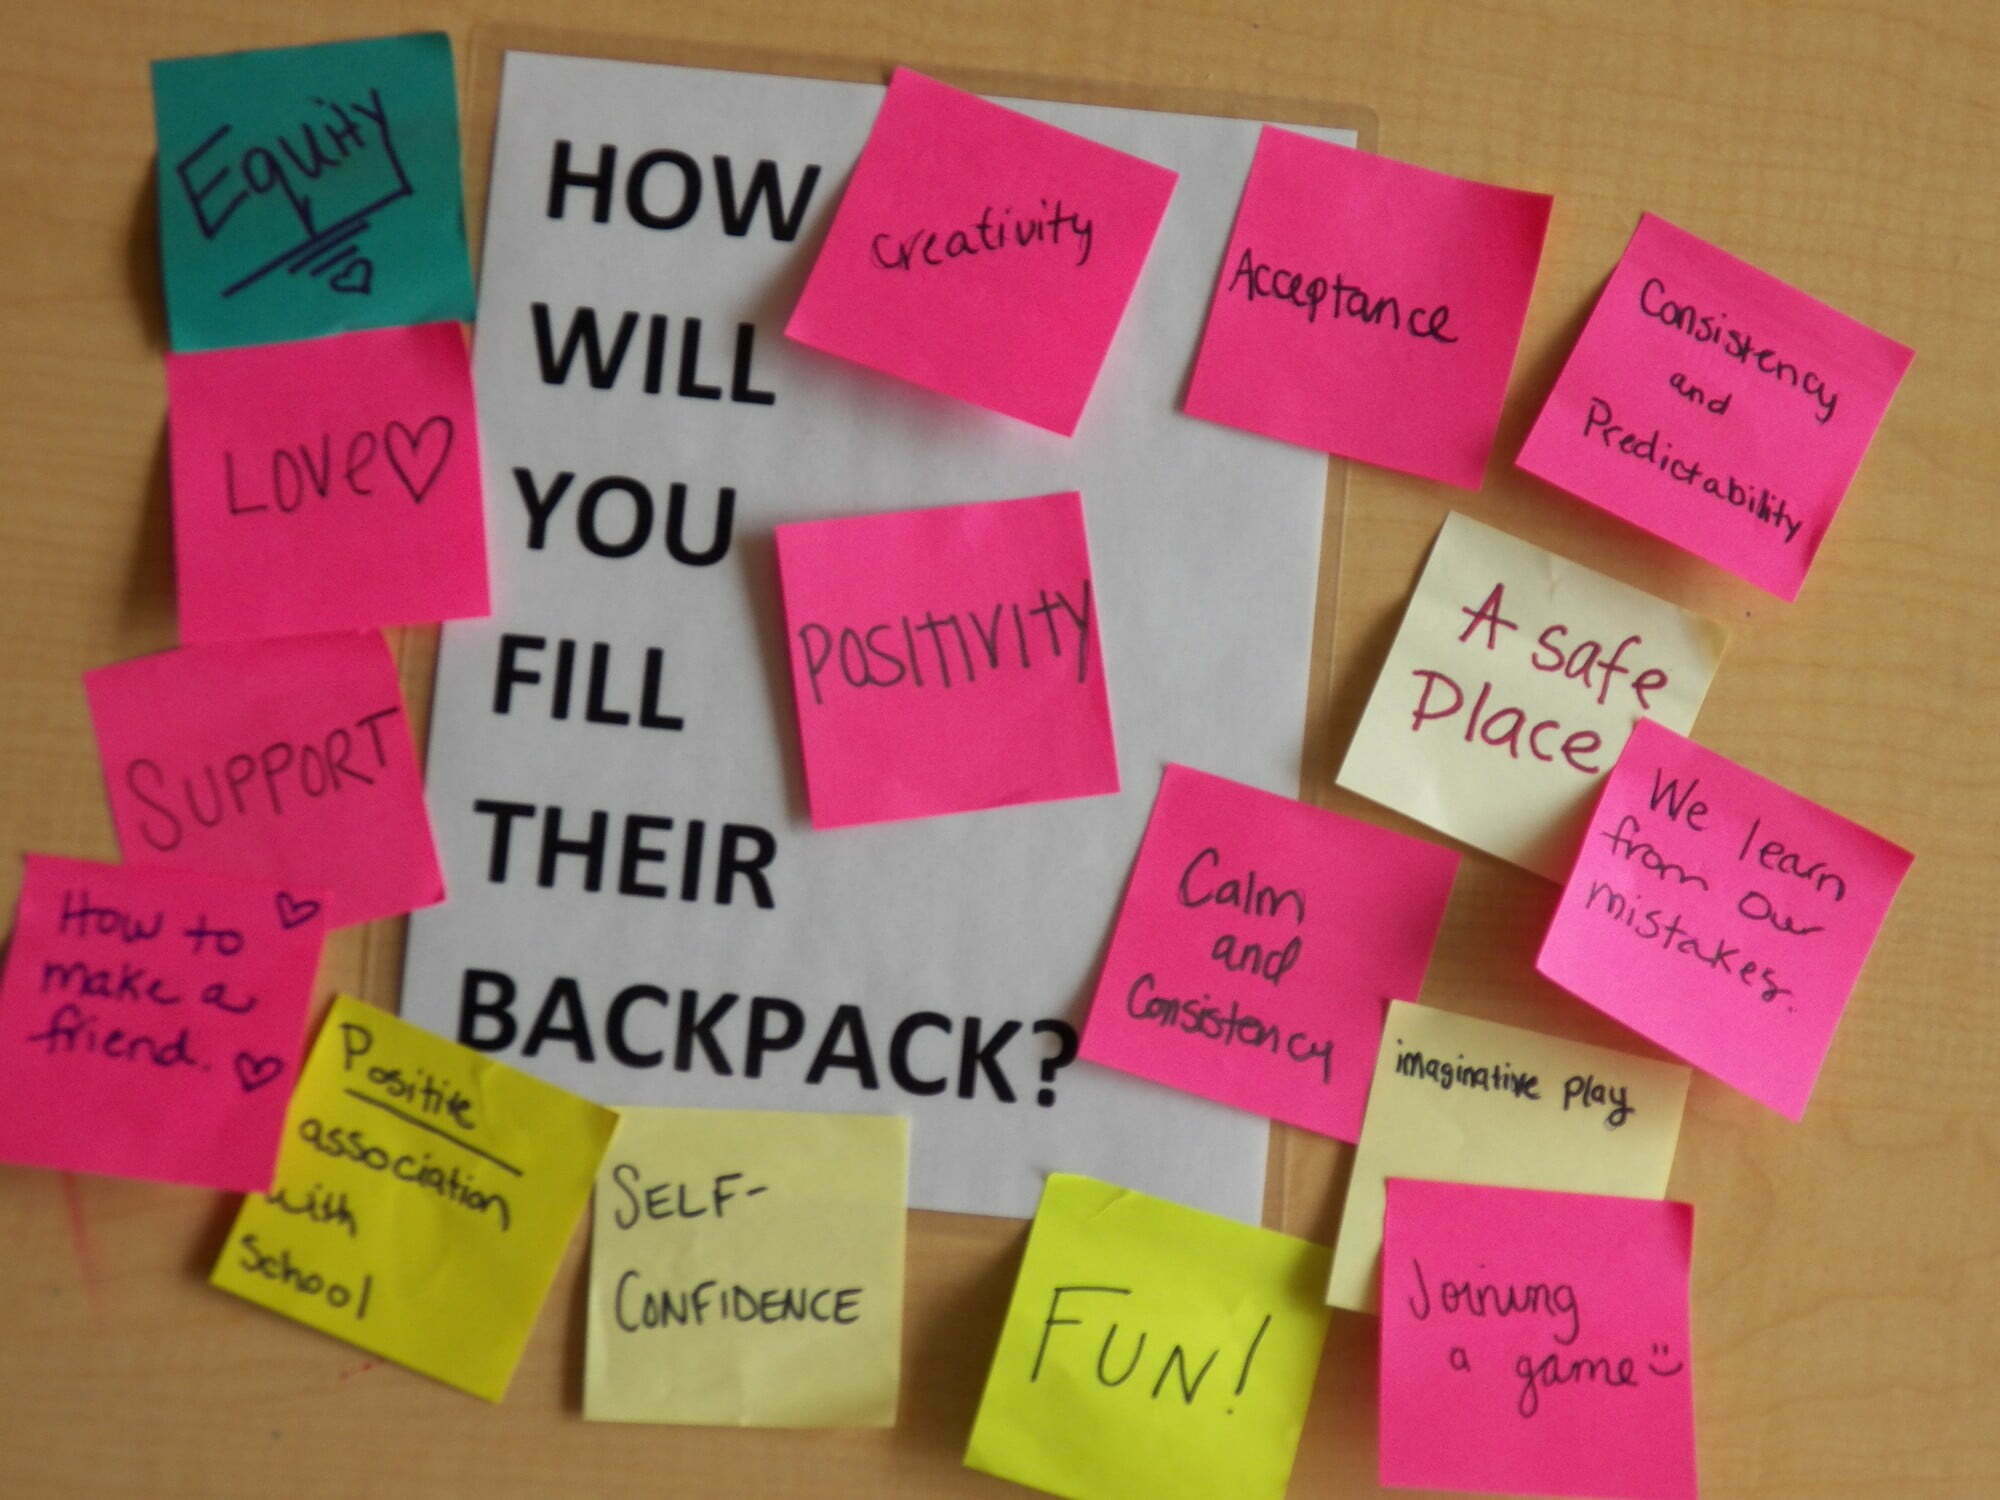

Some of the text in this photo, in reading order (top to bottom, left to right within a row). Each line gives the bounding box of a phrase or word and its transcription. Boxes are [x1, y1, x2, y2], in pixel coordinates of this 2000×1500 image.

[176, 88, 412, 240] Equity
[547, 140, 820, 241] HOW
[1229, 248, 1458, 344] Acceptance
[531, 302, 775, 405] WILL
[1639, 277, 1838, 424] Consistency
[1670, 370, 1732, 416] and
[512, 467, 736, 566] YOU
[1583, 397, 1802, 543] Predictability
[492, 634, 684, 731] FILL
[800, 580, 1093, 705] POSITIVITY
[1459, 583, 1669, 709] A safe
[1411, 669, 1603, 775] Place
[126, 706, 400, 852] SUPPORT
[475, 800, 778, 909] THEIR
[1602, 815, 1709, 892] from
[1647, 767, 1847, 902] We learn
[58, 892, 244, 955] How to
[1178, 848, 1306, 924] Calm
[40, 960, 258, 1014] make a
[1211, 935, 1302, 984] and
[29, 1005, 212, 1070] friend.
[339, 1022, 477, 1130] Positive
[458, 968, 1079, 1109] BACKPACK?
[1126, 973, 1333, 1084] Consistency
[1395, 1039, 1635, 1130] imaginative play
[265, 1190, 358, 1237] with
[299, 1116, 510, 1231] association
[612, 1164, 770, 1230] SELF-
[614, 1270, 863, 1332] CONFIDENCE
[1031, 1286, 1272, 1415] FUN!
[1409, 1259, 1580, 1346] Joining
[1450, 1346, 1640, 1419] a game
